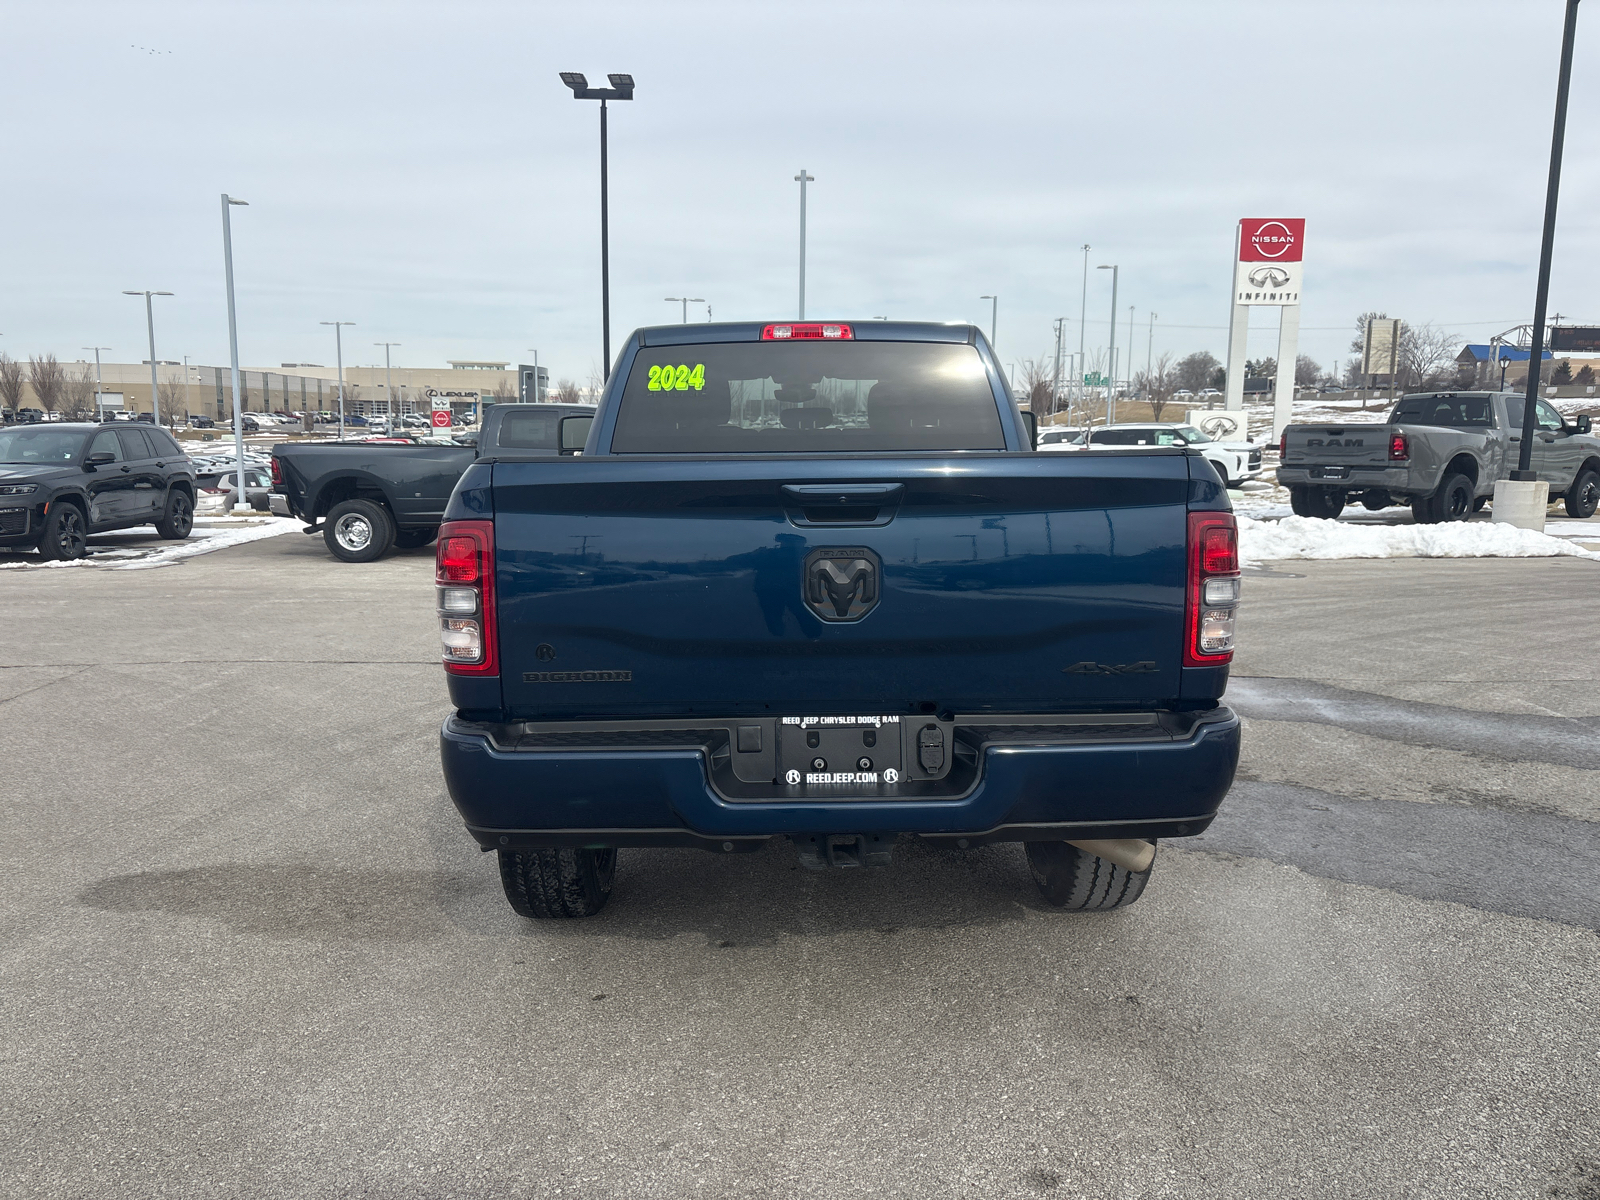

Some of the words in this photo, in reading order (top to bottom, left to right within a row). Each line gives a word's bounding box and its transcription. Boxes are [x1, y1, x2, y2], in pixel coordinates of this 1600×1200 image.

[1238, 292, 1298, 301] INFINITI
[647, 363, 706, 391] 2024
[1306, 439, 1364, 447] RAM
[522, 670, 632, 682] BIGHORN
[782, 716, 800, 724] REED
[802, 716, 819, 725] JEEP
[820, 716, 856, 724] CHRYSLER
[857, 716, 881, 724] DODGE
[882, 715, 899, 723] RAM
[806, 772, 877, 783] REEDJEEP.COM
